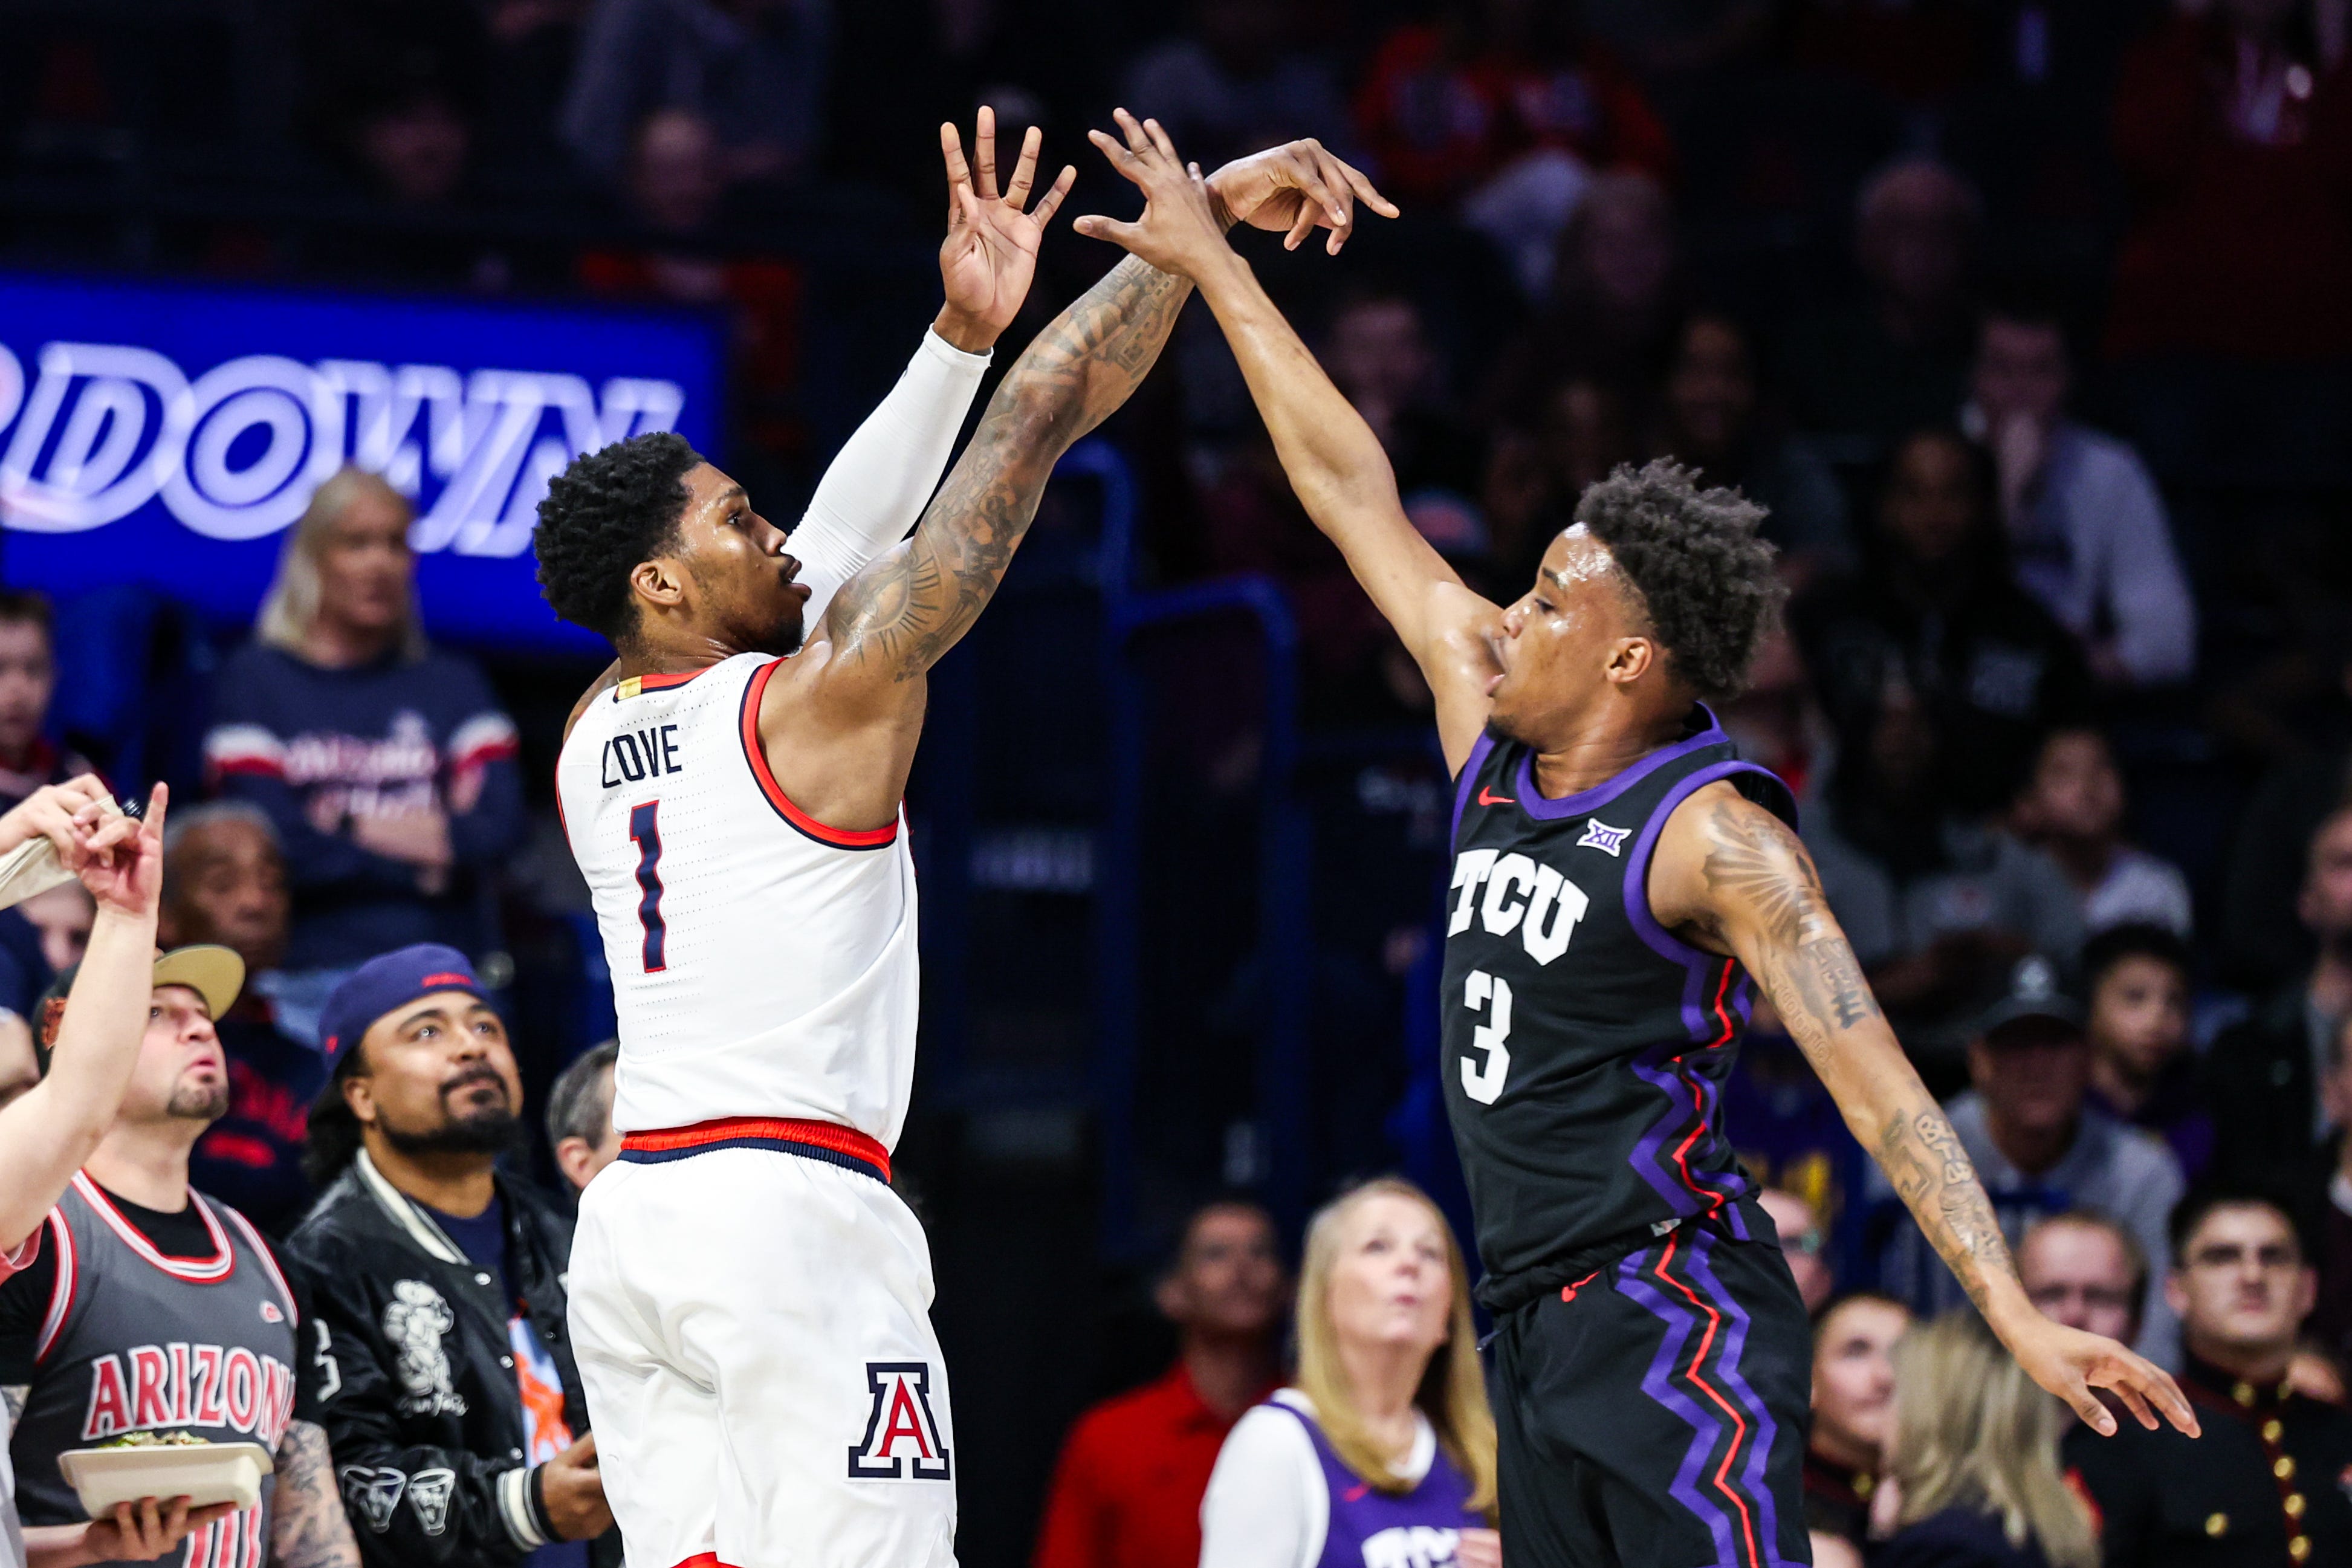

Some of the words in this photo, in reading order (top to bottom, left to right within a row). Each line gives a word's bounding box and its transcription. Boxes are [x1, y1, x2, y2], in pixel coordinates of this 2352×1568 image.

[0, 339, 684, 558] DOWN
[601, 724, 682, 788] LOVE
[629, 799, 667, 974] 1
[1447, 848, 1590, 966] TCU
[1460, 969, 1513, 1106] 3
[81, 1342, 296, 1453] ARIZON
[847, 1362, 951, 1480] A
